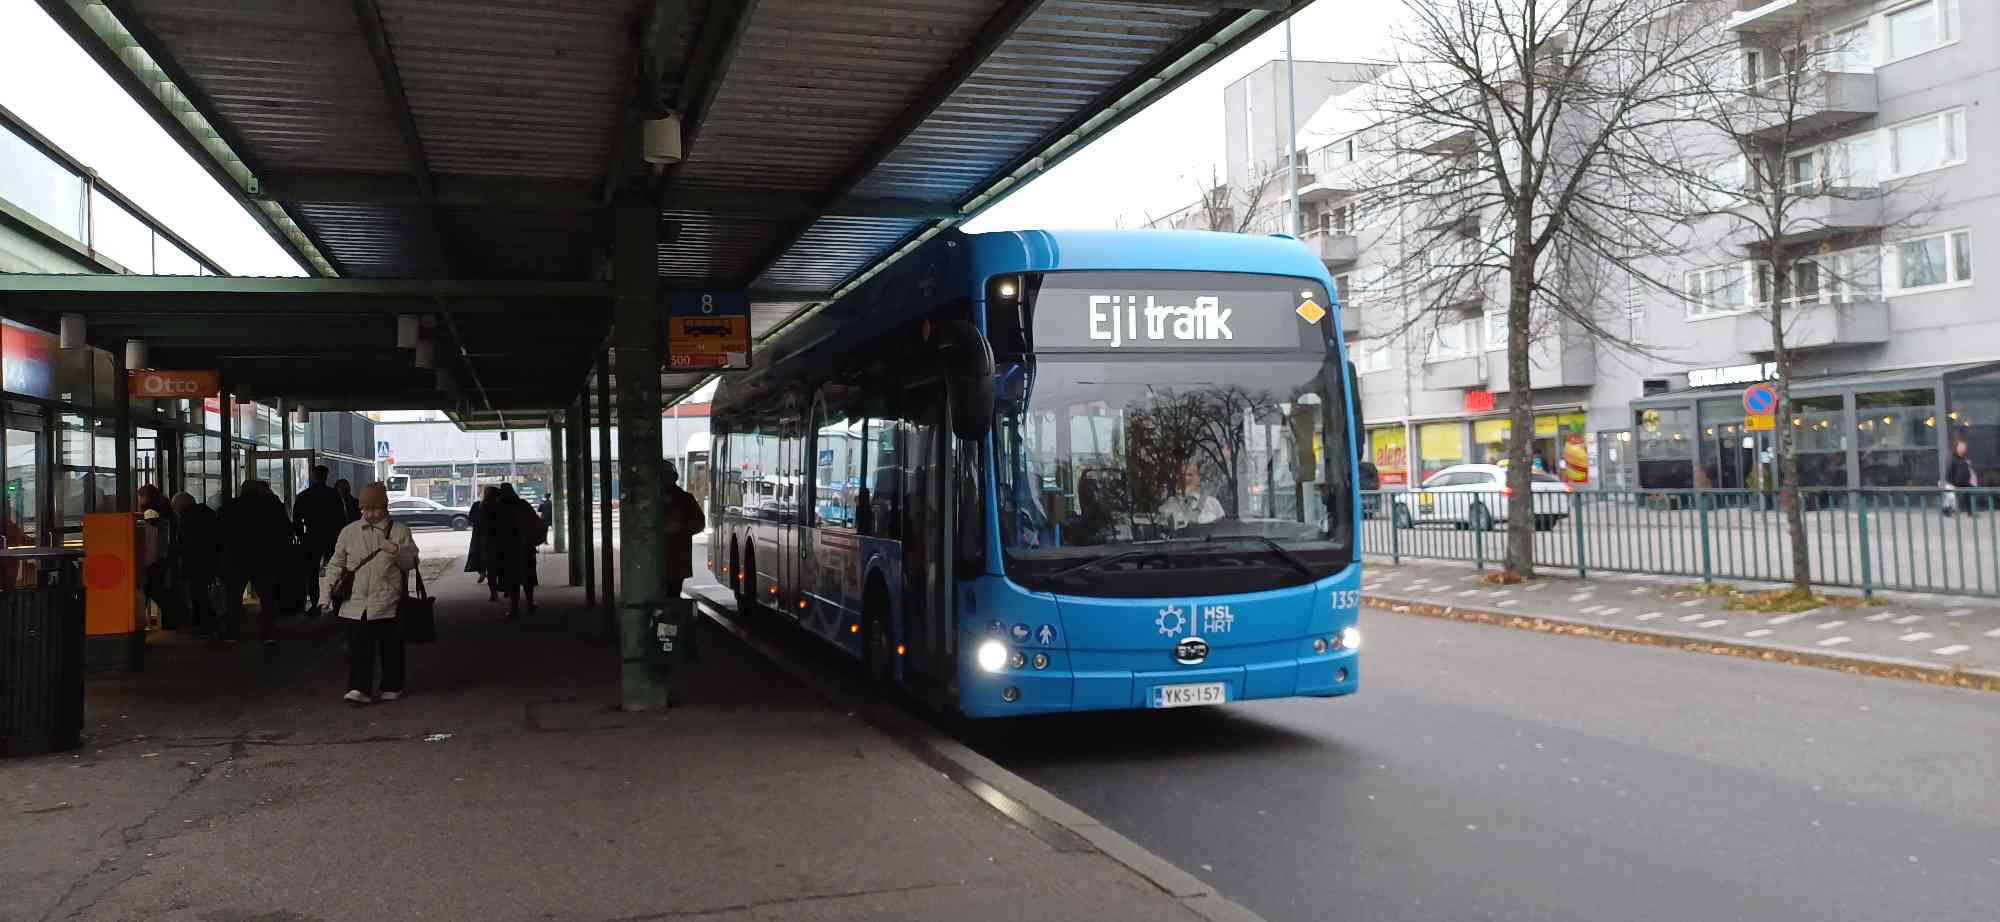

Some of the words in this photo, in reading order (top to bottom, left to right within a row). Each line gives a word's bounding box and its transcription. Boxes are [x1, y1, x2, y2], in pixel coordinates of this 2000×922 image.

[702, 294, 713, 314] 8
[1089, 295, 1121, 348] Ej
[671, 355, 690, 365] 500
[144, 375, 198, 393] Otto
[1331, 590, 1360, 609] 1357
[1204, 605, 1234, 620] HSL
[1204, 619, 1234, 633] HRT
[1165, 686, 1221, 704] YKS-157
